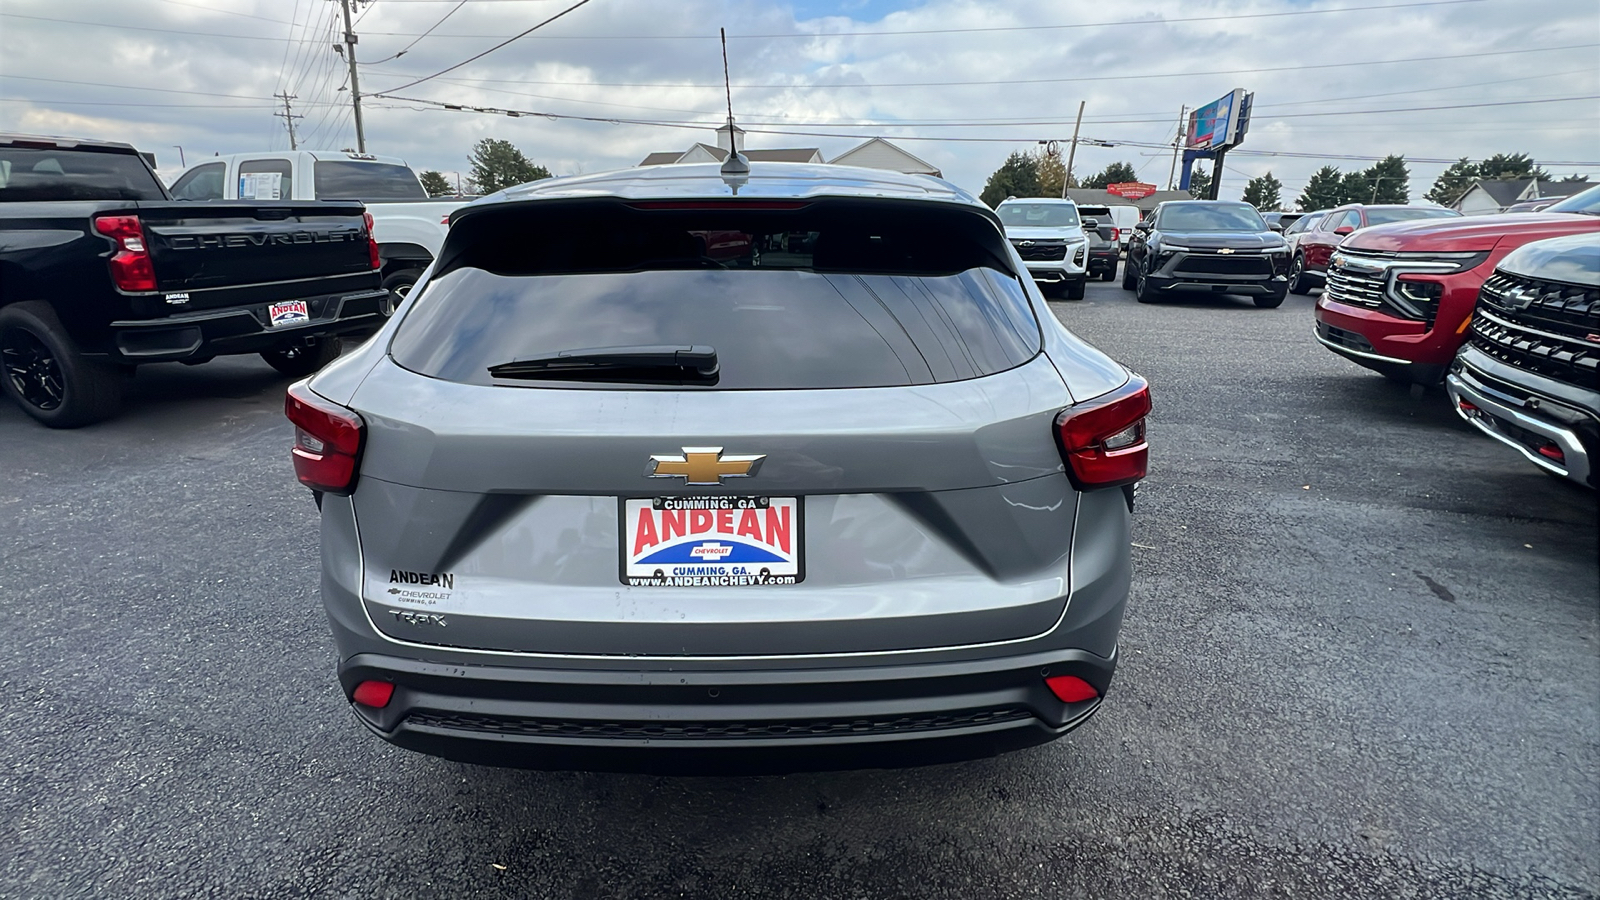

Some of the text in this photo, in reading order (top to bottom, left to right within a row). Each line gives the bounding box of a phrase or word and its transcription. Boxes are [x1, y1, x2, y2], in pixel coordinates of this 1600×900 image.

[172, 230, 359, 250] CHEVROLET
[271, 303, 306, 319] ANDEAN
[664, 500, 757, 509] CUMMING, GA
[633, 505, 791, 557] ANDEAN
[673, 566, 751, 576] CUMMING, GA.
[389, 569, 453, 590] ANDEAN
[629, 576, 795, 586] www.ANDEANCHEVY.com
[402, 590, 451, 600] CHEVROLET
